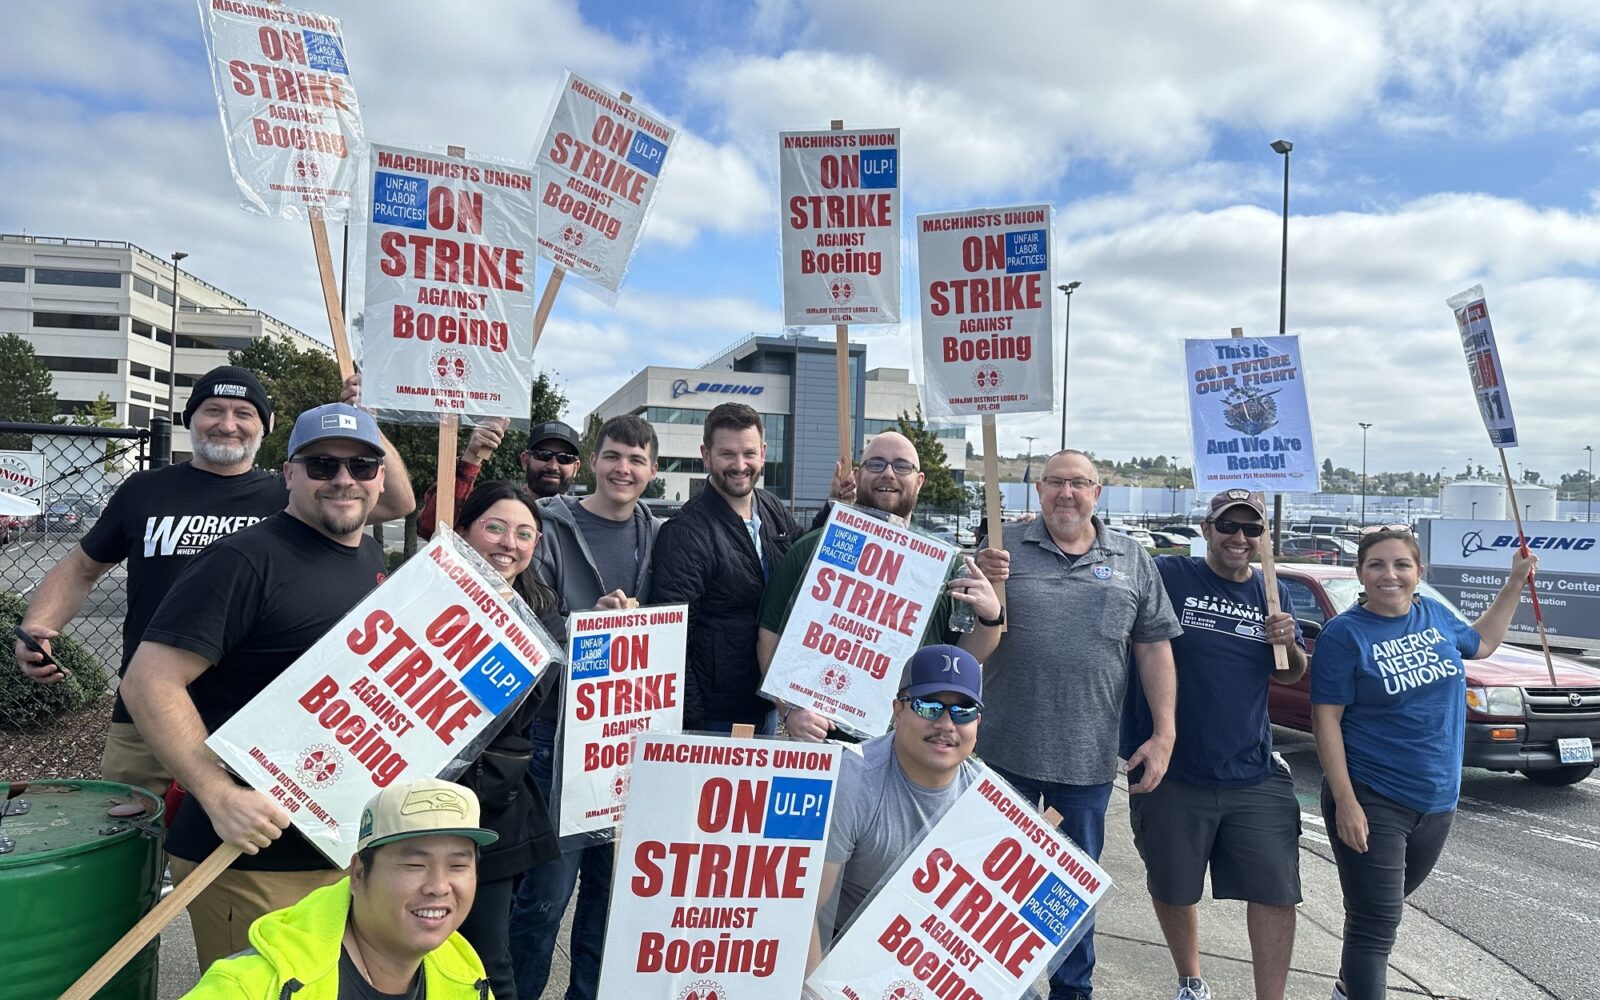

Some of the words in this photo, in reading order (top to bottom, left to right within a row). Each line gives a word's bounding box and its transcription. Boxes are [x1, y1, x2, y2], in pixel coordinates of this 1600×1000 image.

[212, 0, 295, 24] MACHINISTS
[298, 14, 336, 33] UNION
[259, 26, 307, 64] ON
[229, 60, 350, 111] STRIKE
[269, 104, 323, 125] AGAINST
[572, 80, 637, 123] MACHINISTS
[638, 116, 670, 141] UNION
[253, 118, 347, 158] Boeing
[592, 114, 634, 158] ON
[784, 136, 856, 149] MACHINISTS
[859, 134, 895, 146] UNION
[634, 139, 661, 164] ULP!
[378, 152, 480, 182] MACHINISTS
[484, 170, 532, 192] UNION
[550, 132, 649, 206] STRIKE
[820, 154, 859, 189] ON
[864, 158, 893, 174] ULP!
[385, 176, 418, 193] UNFAIR
[386, 191, 416, 206] LABOR
[566, 176, 614, 208] AGAINST
[374, 202, 426, 221] PRACTICES!
[428, 185, 483, 235] ON
[542, 181, 622, 241] Boeing
[790, 194, 892, 230] STRIKE
[923, 214, 1001, 232] MACHINISTS
[1004, 210, 1044, 225] UNION
[816, 232, 865, 247] AGAINST
[1014, 232, 1039, 244] UNFAIR
[1015, 244, 1038, 254] LABOR
[380, 231, 524, 292] STRIKE
[801, 248, 882, 276] Boeing
[962, 234, 1005, 272] ON
[1007, 254, 1046, 266] PRACTICES!
[417, 287, 487, 311] AGAINST
[929, 274, 1042, 317] STRIKE
[393, 304, 508, 353] Boeing
[959, 317, 1013, 334] AGAINST
[942, 334, 1032, 363] Boeing
[1215, 345, 1251, 359] This
[1253, 344, 1269, 357] Is
[1195, 365, 1228, 382] OUR
[1232, 354, 1290, 375] FUTURE
[1196, 378, 1237, 395] OUR
[1242, 367, 1297, 387] FIGHT
[396, 385, 429, 396] IAM&AW
[430, 387, 464, 399] DISTRICT
[489, 390, 501, 401] 751
[695, 382, 764, 395] BOEING
[974, 396, 999, 404] DISTRICT
[1207, 438, 1239, 454] And
[1242, 437, 1271, 452] We
[1273, 436, 1302, 451] Are
[1227, 454, 1286, 470] Ready!
[144, 516, 268, 558] WORKER
[181, 534, 224, 546] STRIK
[832, 540, 854, 553] LABOR
[834, 529, 858, 544] UNFAIR
[835, 510, 909, 546] MACHINISTS
[909, 539, 947, 562] UNION
[1491, 535, 1596, 550] BOEING
[821, 546, 857, 565] PRACTICES!
[857, 542, 905, 586] ON
[1461, 574, 1501, 585] Seattle
[1558, 580, 1600, 592] Center
[429, 544, 510, 628] MACHINISTS
[504, 622, 543, 667] UNION
[811, 567, 922, 636] STRIKE
[1461, 591, 1488, 601] Boeing
[1520, 596, 1566, 606] Evuation
[1461, 600, 1483, 608] Flight
[577, 614, 647, 631] MACHINISTS
[650, 611, 683, 625] UNION
[1461, 609, 1479, 617] Gate
[425, 604, 494, 672] ON
[828, 613, 882, 644] AGAINST
[1520, 624, 1535, 632] Way
[580, 638, 603, 649] UNFAIR
[580, 649, 602, 660] LABOR
[610, 634, 649, 673] ON
[802, 621, 891, 680] Boeing
[1372, 627, 1447, 660] AMERICA
[572, 658, 609, 673] PRACTICES!
[1377, 646, 1439, 677] NEEDS
[346, 609, 482, 746] STRIKE
[480, 656, 522, 697] ULP!
[1384, 659, 1462, 695] UNIONS.
[349, 676, 415, 738] AGAINST
[576, 673, 677, 721] STRIKE
[813, 690, 839, 708] DISTRICT
[839, 701, 856, 714] LODGE
[856, 708, 866, 718] 751
[298, 674, 408, 788] Boeing
[602, 717, 651, 738] AGAINST
[584, 736, 637, 772] Boei
[643, 742, 768, 767] MACHINISTS
[772, 750, 833, 772] UNION
[249, 746, 281, 776] IAM&AW
[277, 773, 311, 803] DISTRICT
[306, 799, 329, 821] LODGE
[325, 817, 340, 831] 75
[270, 785, 300, 813] AFL-CIO
[586, 808, 609, 818] IAM&AW
[610, 804, 626, 814] DIST
[697, 777, 768, 834] ON
[774, 792, 823, 817] ULP!
[977, 779, 1060, 858] MACHINISTS
[1056, 850, 1100, 894] UNION
[631, 841, 811, 898] STRIKE
[982, 836, 1047, 904] ON
[1042, 898, 1069, 920] LABOR
[1051, 882, 1080, 910] UNFAIR
[671, 906, 758, 928] AGAINST
[912, 847, 1046, 979] STRIKE
[1025, 897, 1069, 939] PRACTICES!
[636, 932, 779, 977] Boeing
[920, 913, 983, 973] AGAINST
[842, 986, 860, 1000] IAM
